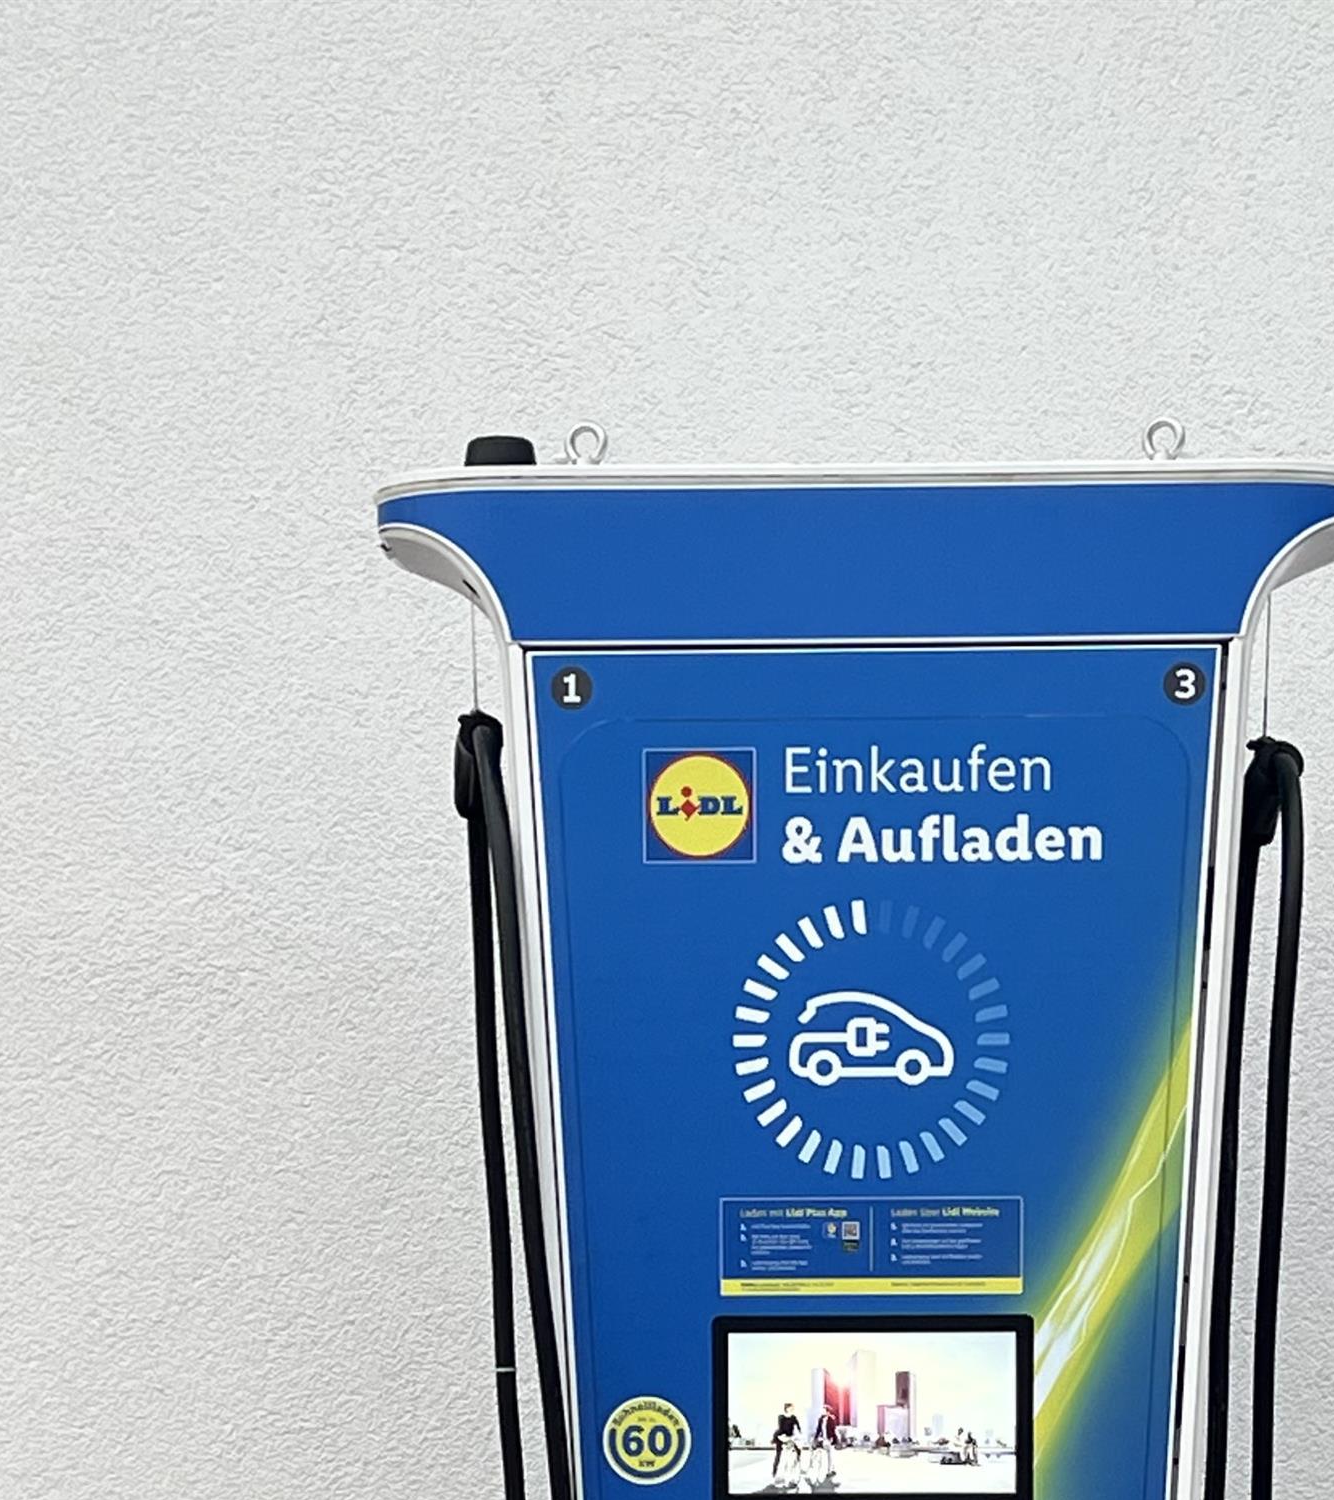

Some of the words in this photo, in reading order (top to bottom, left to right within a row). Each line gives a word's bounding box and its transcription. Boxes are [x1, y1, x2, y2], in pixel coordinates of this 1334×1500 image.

[562, 674, 581, 703] 1
[1174, 669, 1196, 698] 3
[784, 743, 1053, 794] Einkaufen
[783, 817, 823, 864] &
[836, 815, 1104, 863] Aufladen
[622, 1424, 672, 1457] 60
